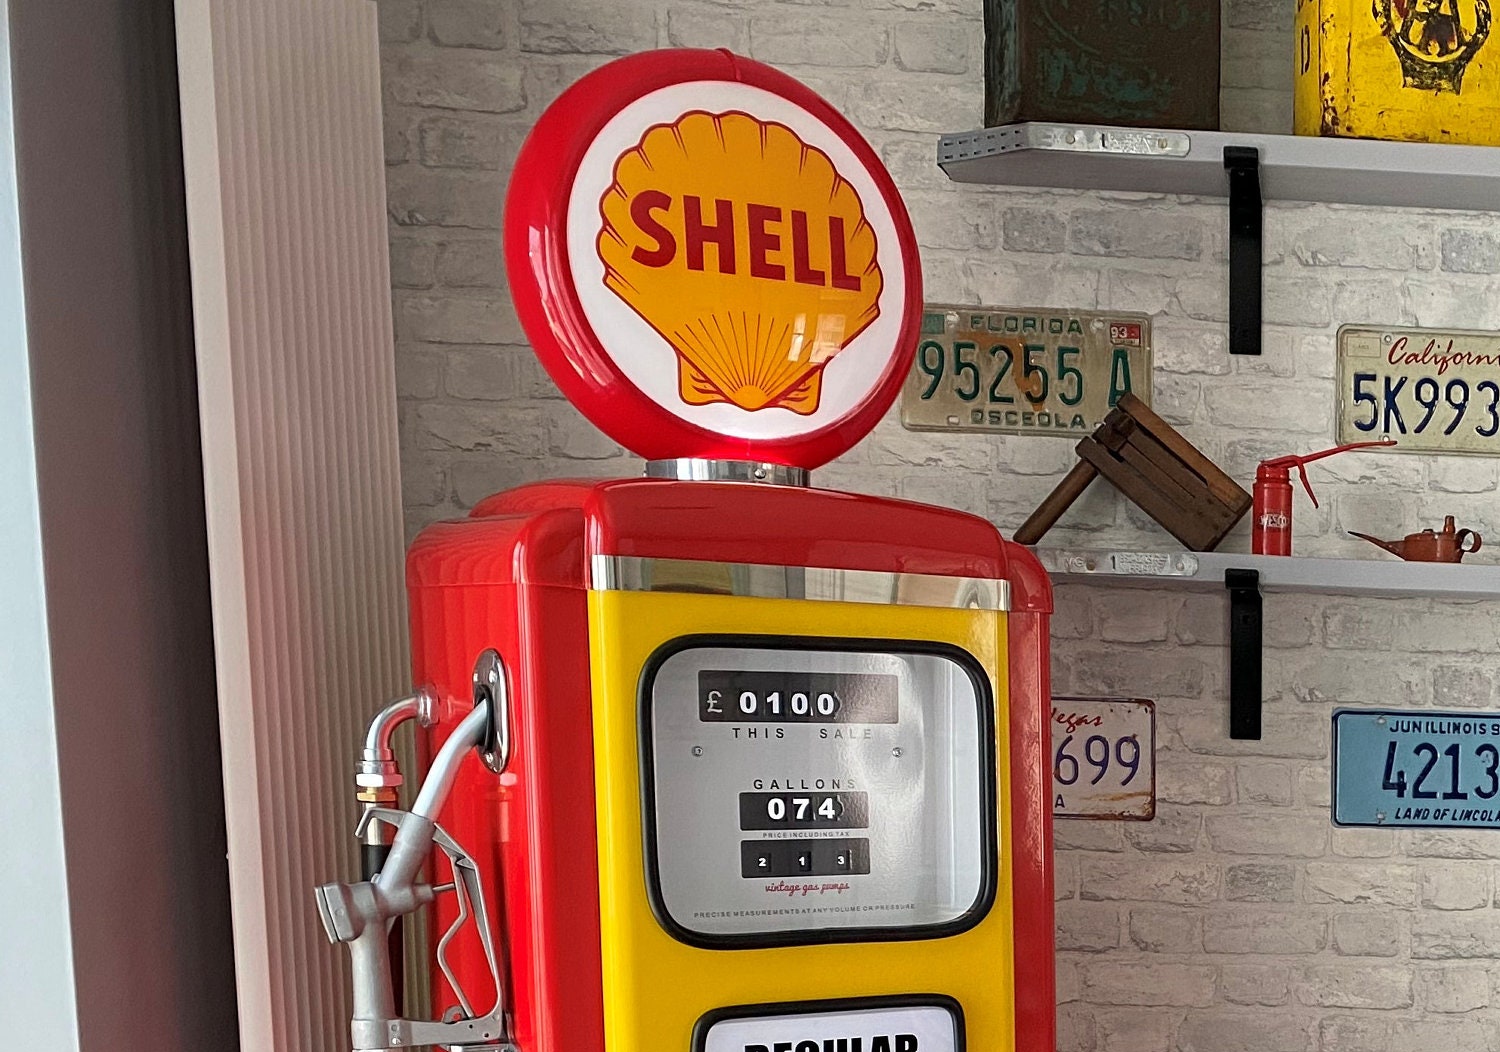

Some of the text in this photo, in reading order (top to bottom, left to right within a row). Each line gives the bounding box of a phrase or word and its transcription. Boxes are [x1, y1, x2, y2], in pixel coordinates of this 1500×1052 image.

[629, 189, 862, 292] SHELL
[970, 314, 1084, 335] FLORIDA
[1110, 326, 1128, 338] 93
[918, 340, 1084, 406] 95255
[970, 408, 1086, 429] OSCEOLA
[706, 690, 723, 713] £
[732, 727, 872, 740] THIS SALE
[1389, 720, 1422, 733] JUN
[1425, 721, 1487, 735] ILLINOIS
[1382, 741, 1500, 800] 4213
[753, 779, 857, 790] GALLONS
[767, 796, 837, 821] 074
[1394, 807, 1430, 820] LAND
[1433, 808, 1450, 820] OF
[765, 880, 850, 897] vintage gas pumps
[733, 908, 800, 917] MEASUREMENTS
[829, 905, 861, 913] VOLUME
[875, 903, 915, 911] PRESSURE
